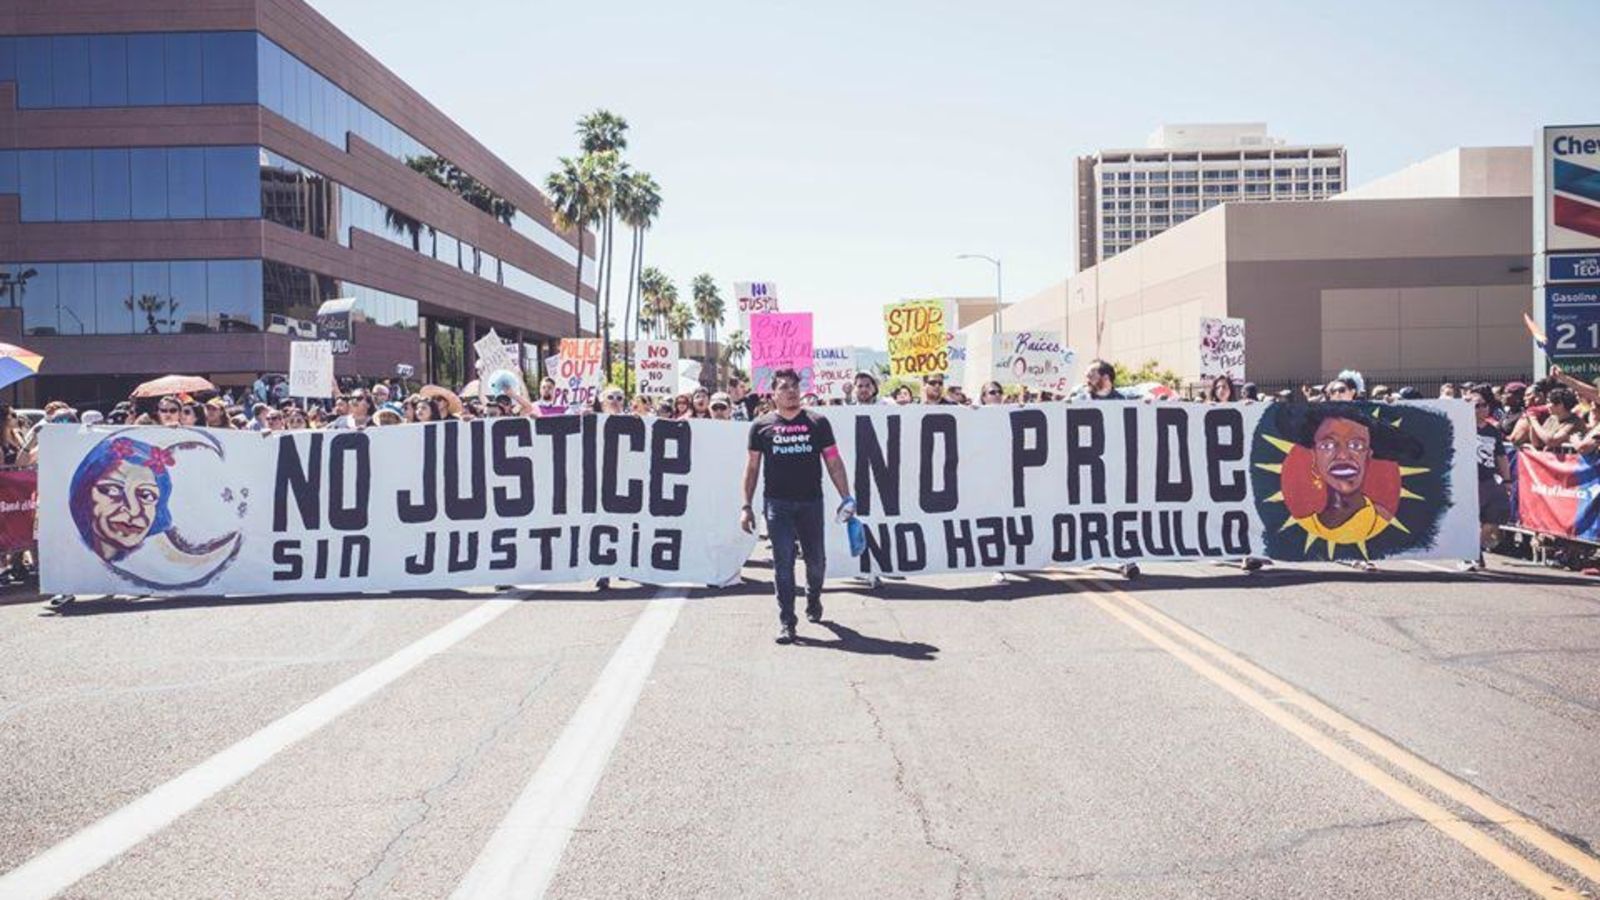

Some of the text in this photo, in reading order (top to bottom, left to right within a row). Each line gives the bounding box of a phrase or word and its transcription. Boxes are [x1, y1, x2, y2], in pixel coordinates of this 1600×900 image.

[1552, 293, 1598, 302] Gasoline
[888, 306, 943, 336] STOP
[561, 339, 601, 360] POLICE
[648, 345, 668, 358] NO
[561, 359, 599, 378] OUT
[649, 371, 663, 380] NO
[553, 386, 596, 405] PRIDE
[773, 425, 808, 433] Trans
[773, 434, 811, 444] Queer
[773, 444, 813, 454] Pueblo
[273, 433, 371, 532] NO
[854, 414, 959, 516] NO
[860, 523, 927, 573] NO
[1052, 510, 1251, 562] ORGULLO
